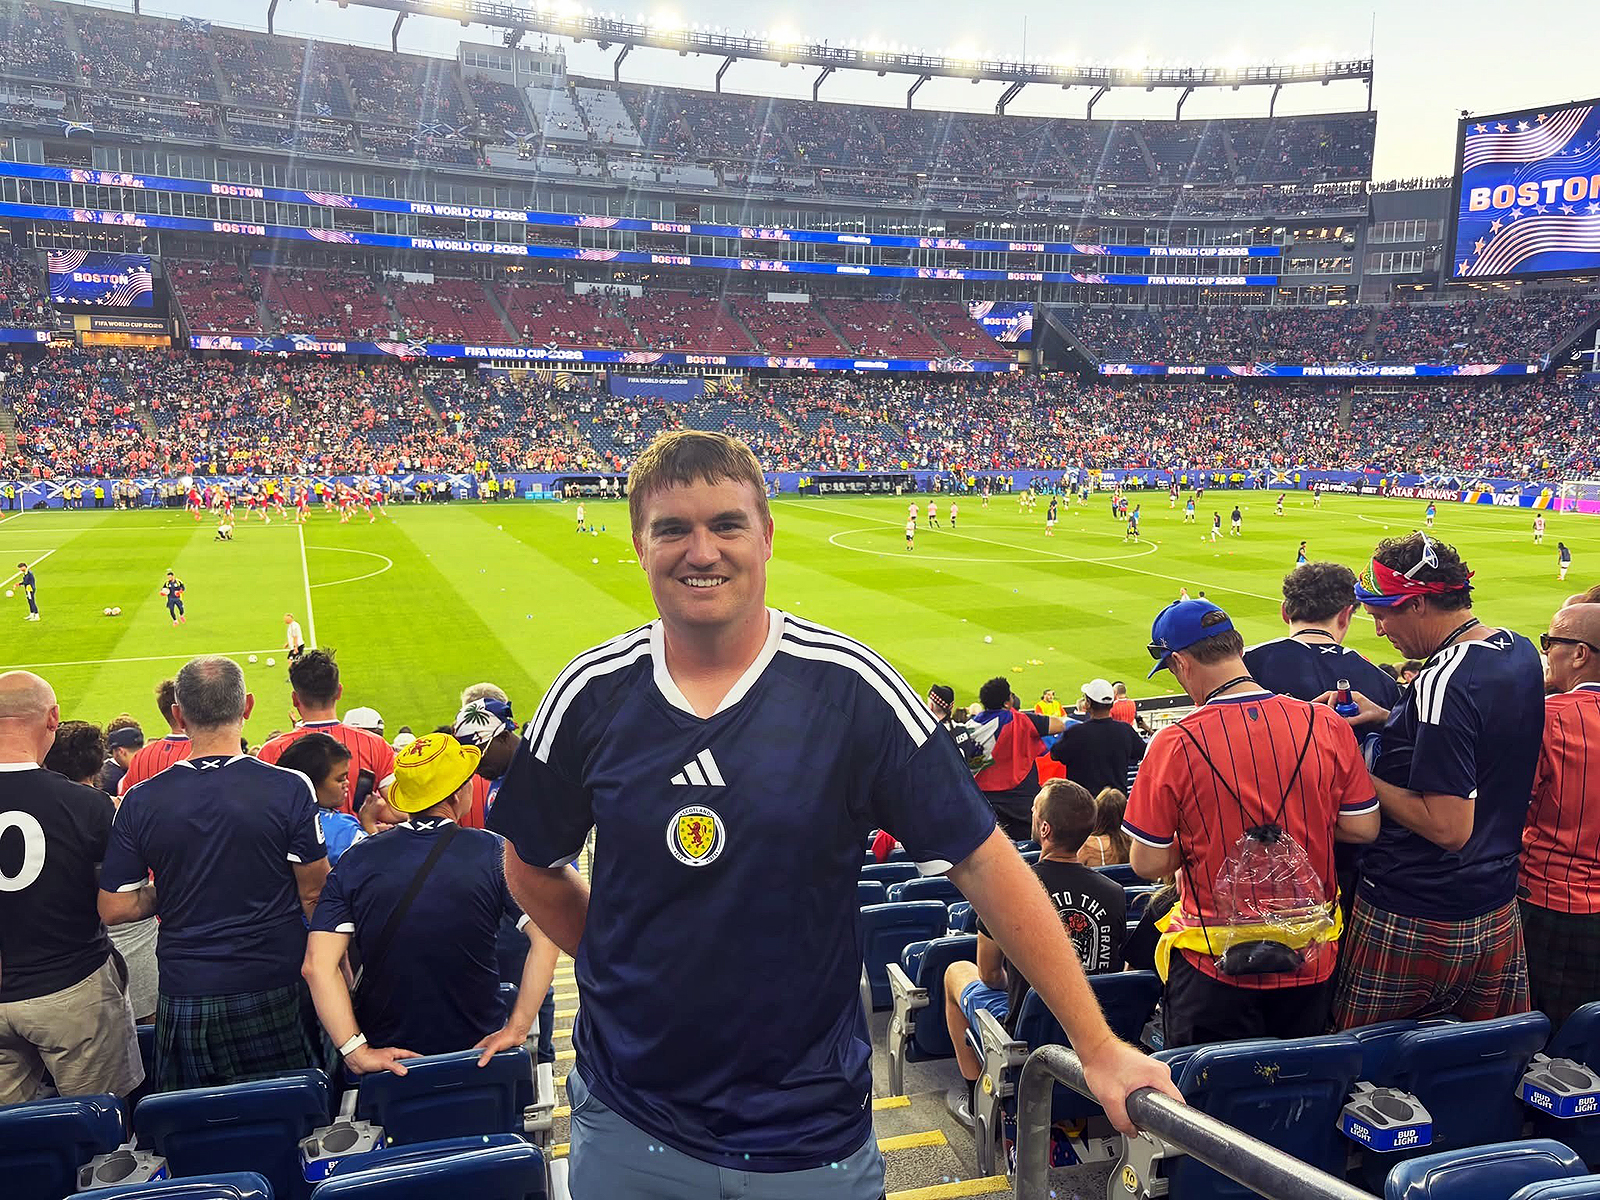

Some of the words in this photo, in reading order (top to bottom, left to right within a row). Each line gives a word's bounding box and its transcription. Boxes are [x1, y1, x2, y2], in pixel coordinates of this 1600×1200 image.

[211, 184, 264, 198] BOSTON
[410, 204, 433, 214] FIFA
[433, 205, 470, 216] WORLD
[472, 208, 492, 218] CUP
[213, 222, 266, 236] BOSTON
[652, 222, 690, 234] BOSTON
[412, 238, 434, 249] FIFA
[434, 240, 471, 250] WORLD
[472, 243, 492, 252] CUP
[494, 244, 528, 254] 2026
[1010, 243, 1044, 252] BOSTON
[1150, 248, 1168, 256] FIFA
[1168, 248, 1198, 256] WORLD
[1200, 248, 1218, 256] CUP
[652, 254, 690, 266] BOSTON
[73, 272, 129, 284] BOSTON
[1008, 272, 1042, 281] BOSTON
[1148, 276, 1166, 284] FIFA
[1166, 276, 1196, 284] WORLD
[1198, 276, 1215, 285] CUP
[983, 317, 1018, 326] BOSTON
[464, 346, 488, 356] FIFA
[488, 348, 526, 358] WORLD
[526, 349, 546, 358] CUP
[686, 355, 726, 365] BOSTON
[1168, 366, 1206, 374] BOSTON
[1302, 367, 1322, 376] FIFA
[1324, 367, 1358, 376] WORLD
[1359, 367, 1379, 376] CUP
[1416, 488, 1458, 500] AIRWAYS
[1490, 493, 1520, 506] VISA
[1052, 892, 1072, 906] TO
[1081, 894, 1106, 920] THE
[1098, 926, 1110, 968] GRAVE
[1534, 1092, 1550, 1102] BUD
[1578, 1097, 1596, 1106] BUD
[1530, 1096, 1554, 1110] LIGHT
[1574, 1103, 1598, 1112] LIGHT
[1353, 1123, 1369, 1134] BUD
[1398, 1130, 1416, 1138] BUD
[1350, 1127, 1372, 1142] LIGHT
[1394, 1136, 1418, 1146] LIGHT
